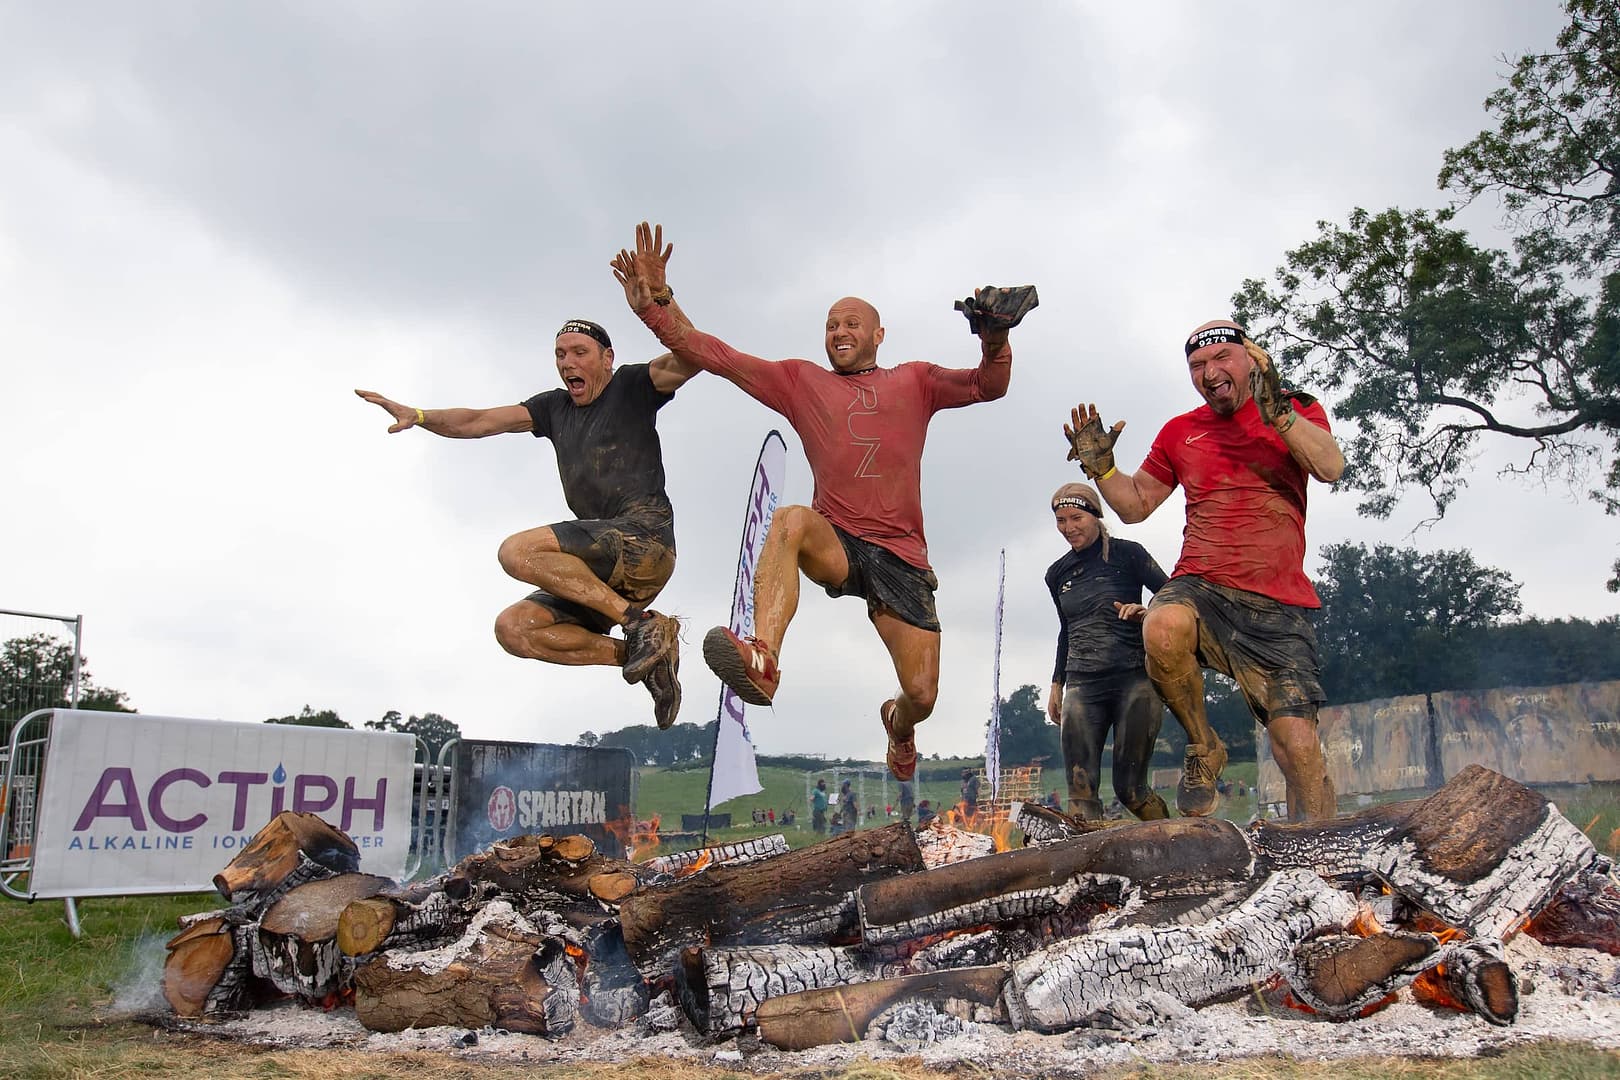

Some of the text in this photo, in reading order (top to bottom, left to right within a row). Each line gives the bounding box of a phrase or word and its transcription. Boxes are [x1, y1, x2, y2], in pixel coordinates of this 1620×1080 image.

[1198, 328, 1236, 340] SPARTAN
[1198, 336, 1227, 348] 9279
[518, 790, 607, 828] SPARTAN
[68, 836, 194, 851] ALKALINE
